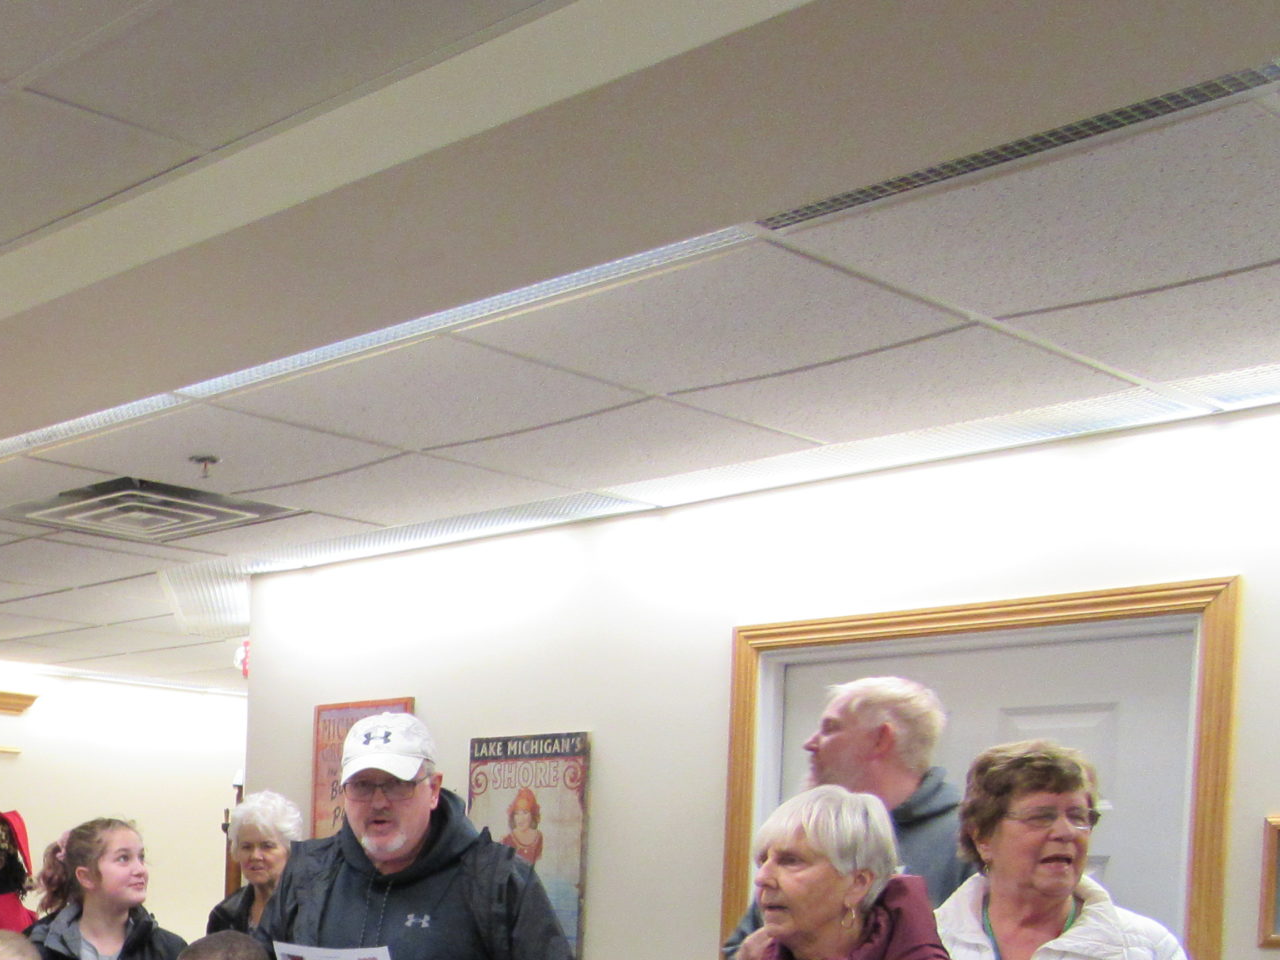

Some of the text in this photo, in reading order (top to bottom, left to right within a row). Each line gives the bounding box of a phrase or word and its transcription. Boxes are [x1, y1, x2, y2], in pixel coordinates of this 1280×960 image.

[474, 737, 581, 757] LAKE MICHIGAN'S
[492, 760, 560, 790] SHORE
